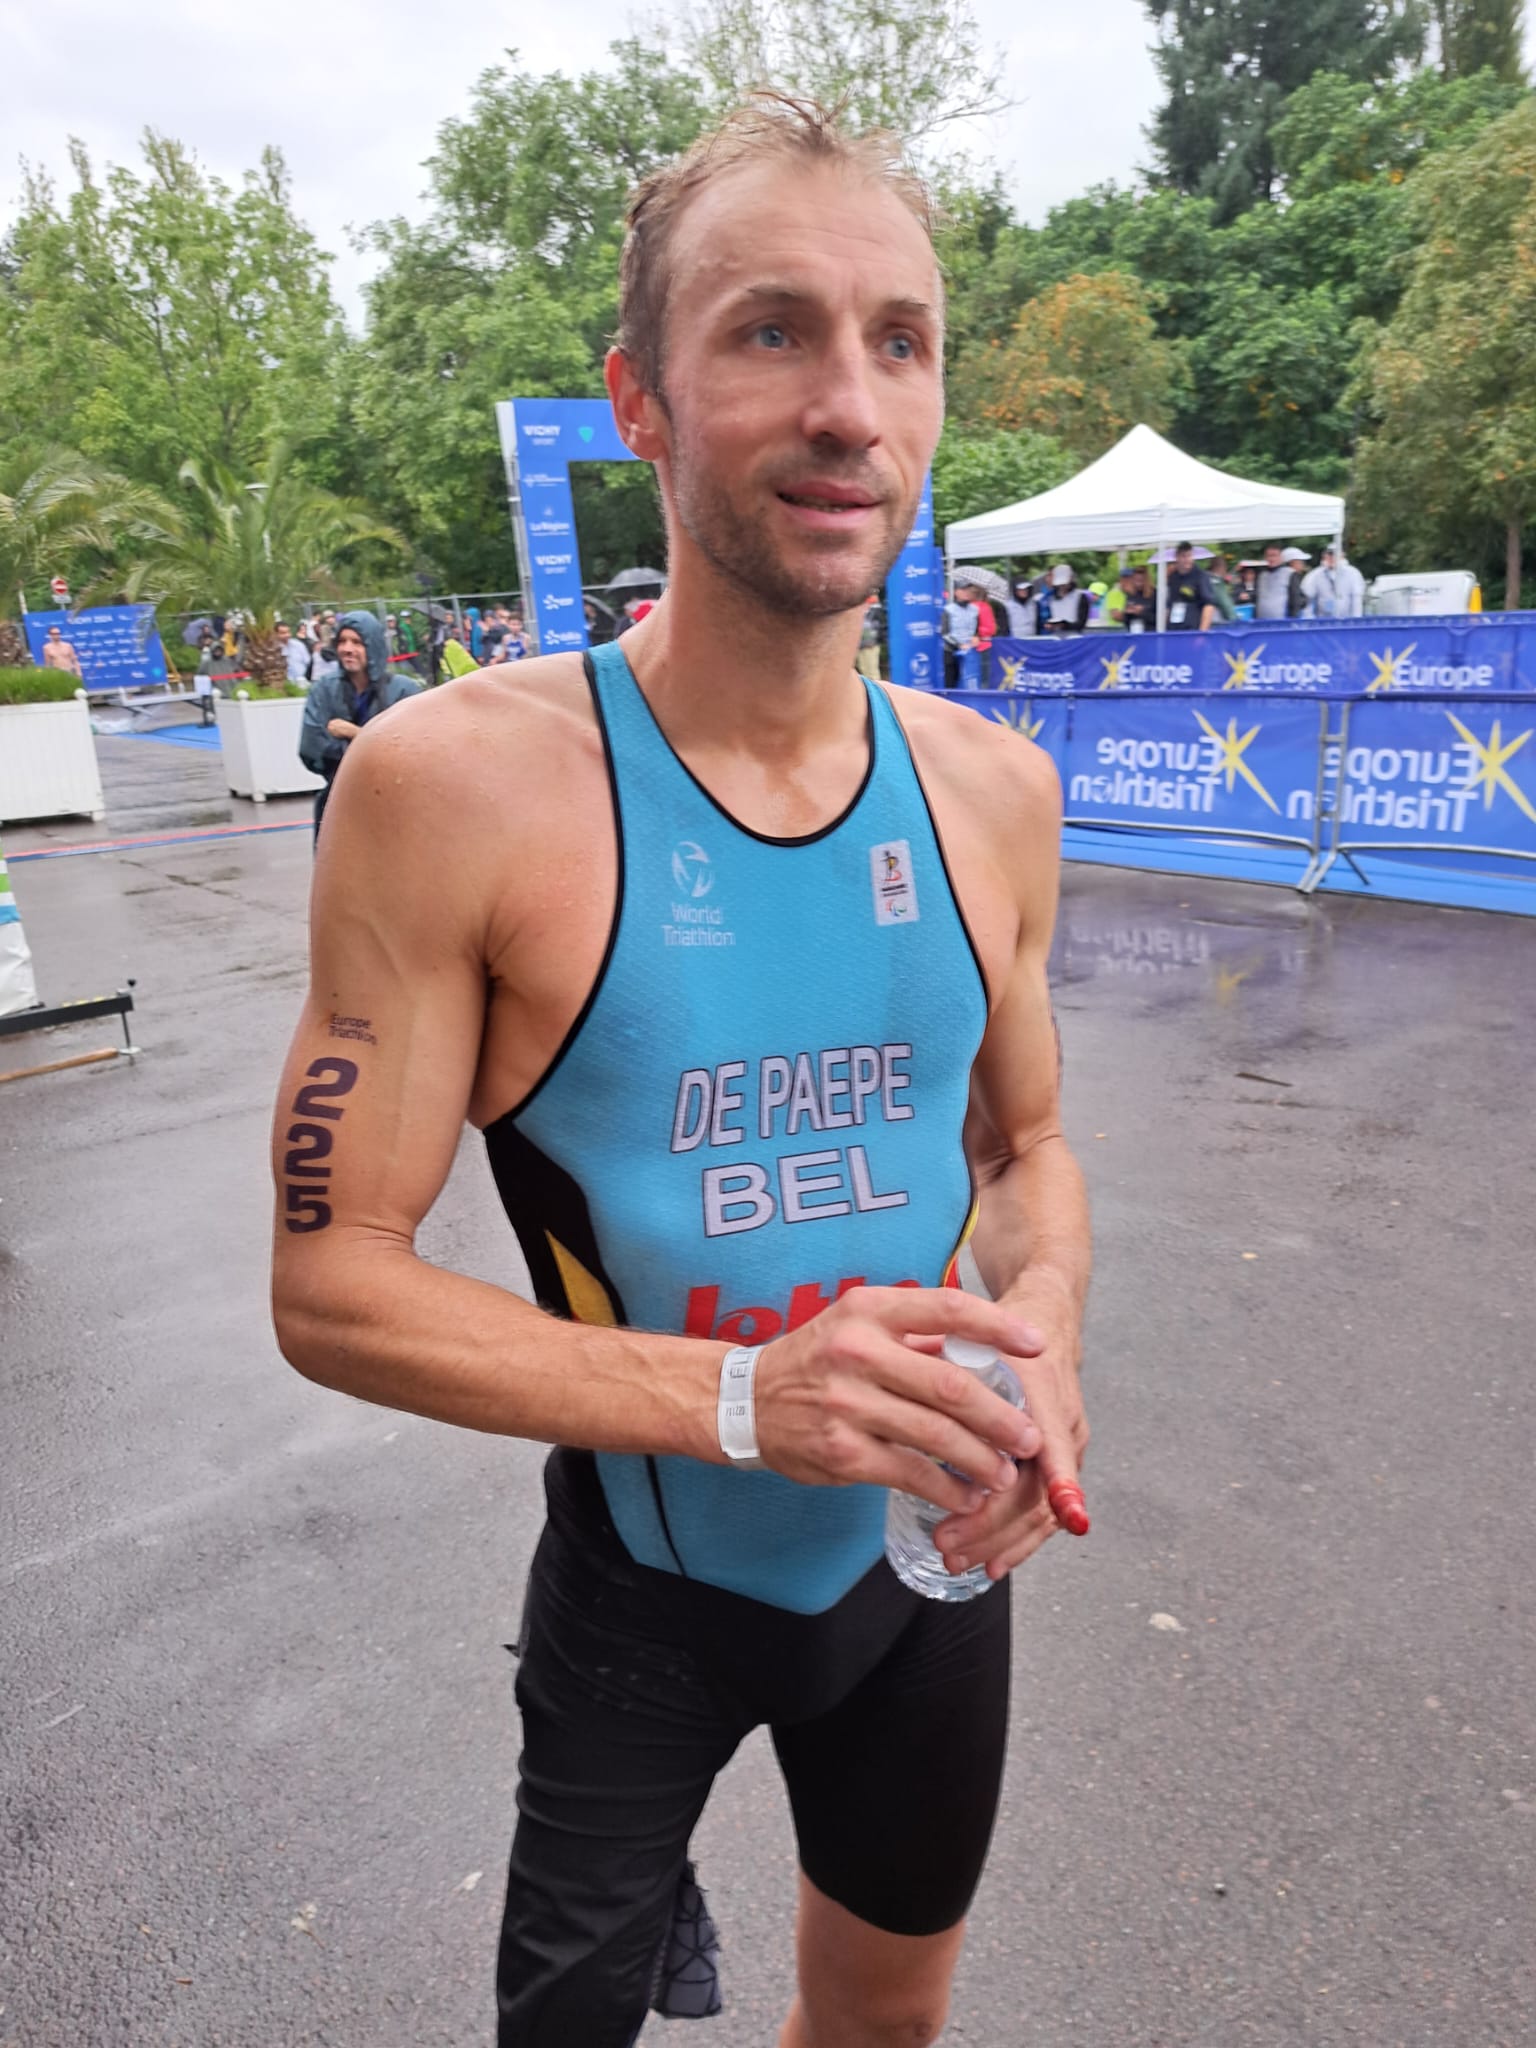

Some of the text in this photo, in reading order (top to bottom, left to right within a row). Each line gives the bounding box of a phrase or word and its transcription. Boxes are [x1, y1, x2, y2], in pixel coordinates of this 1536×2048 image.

[1015, 668, 1073, 689] Europe
[1118, 660, 1193, 687] Europe
[1243, 659, 1332, 688] Europe
[1394, 659, 1494, 690] Europe
[671, 902, 723, 925] World
[661, 925, 736, 947] Triathlon
[670, 1042, 916, 1154] DE PAEPE
[284, 1056, 360, 1234] 225
[702, 1145, 911, 1238] BEL
